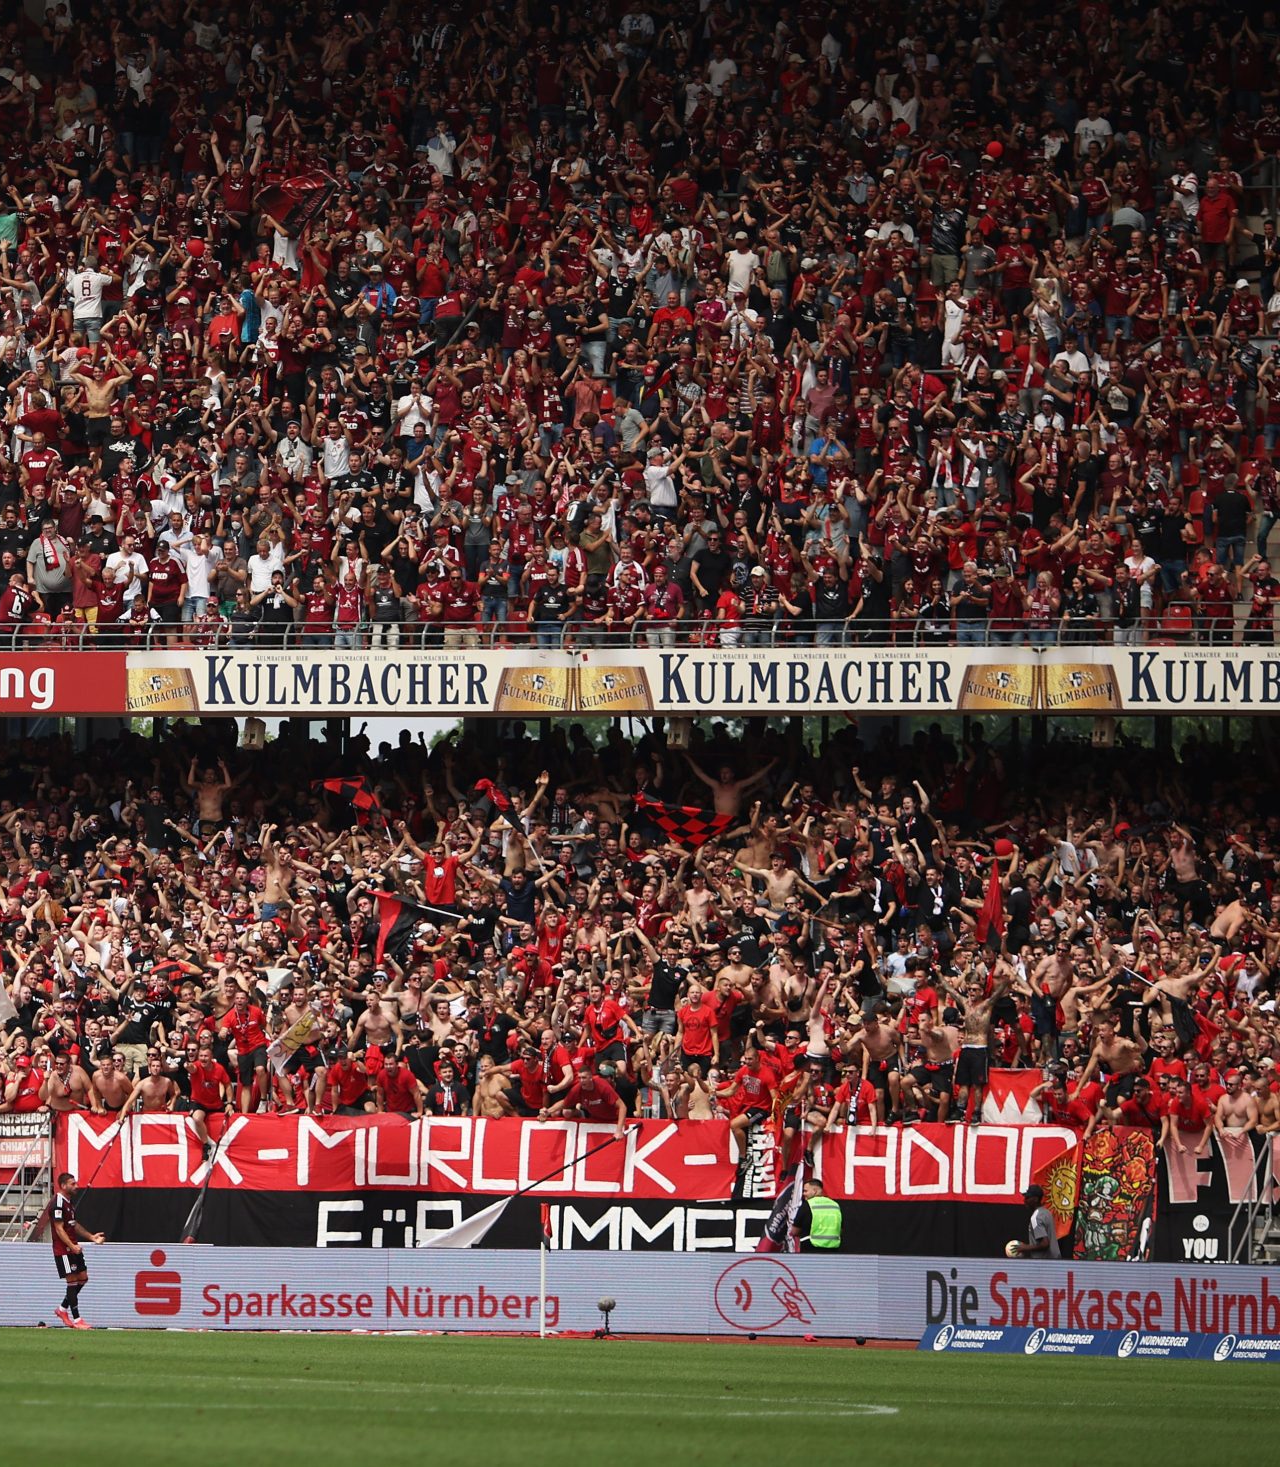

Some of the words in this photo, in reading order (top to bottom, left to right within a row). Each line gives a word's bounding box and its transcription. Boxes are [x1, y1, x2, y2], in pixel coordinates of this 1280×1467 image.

[205, 655, 489, 705] KULMBACHER
[659, 653, 952, 704] KULMBACHER
[126, 686, 191, 710] KULMBACHER
[503, 682, 568, 709] KULMBACHER
[579, 684, 645, 709] KULMBACHER
[966, 681, 1032, 707] KULMBACHER
[1182, 1238, 1219, 1260] YOU
[202, 1283, 373, 1325] Sparkasse
[386, 1285, 559, 1327] Nürnberg
[926, 1267, 979, 1325] Die
[989, 1270, 1163, 1331] Sparkasse
[954, 1329, 1003, 1341] NÜRNBERGER
[1045, 1333, 1094, 1345] NÜRNBERGER
[1139, 1335, 1189, 1347] NÜRNBERGER
[1236, 1340, 1280, 1351] NÜRNBERGE
